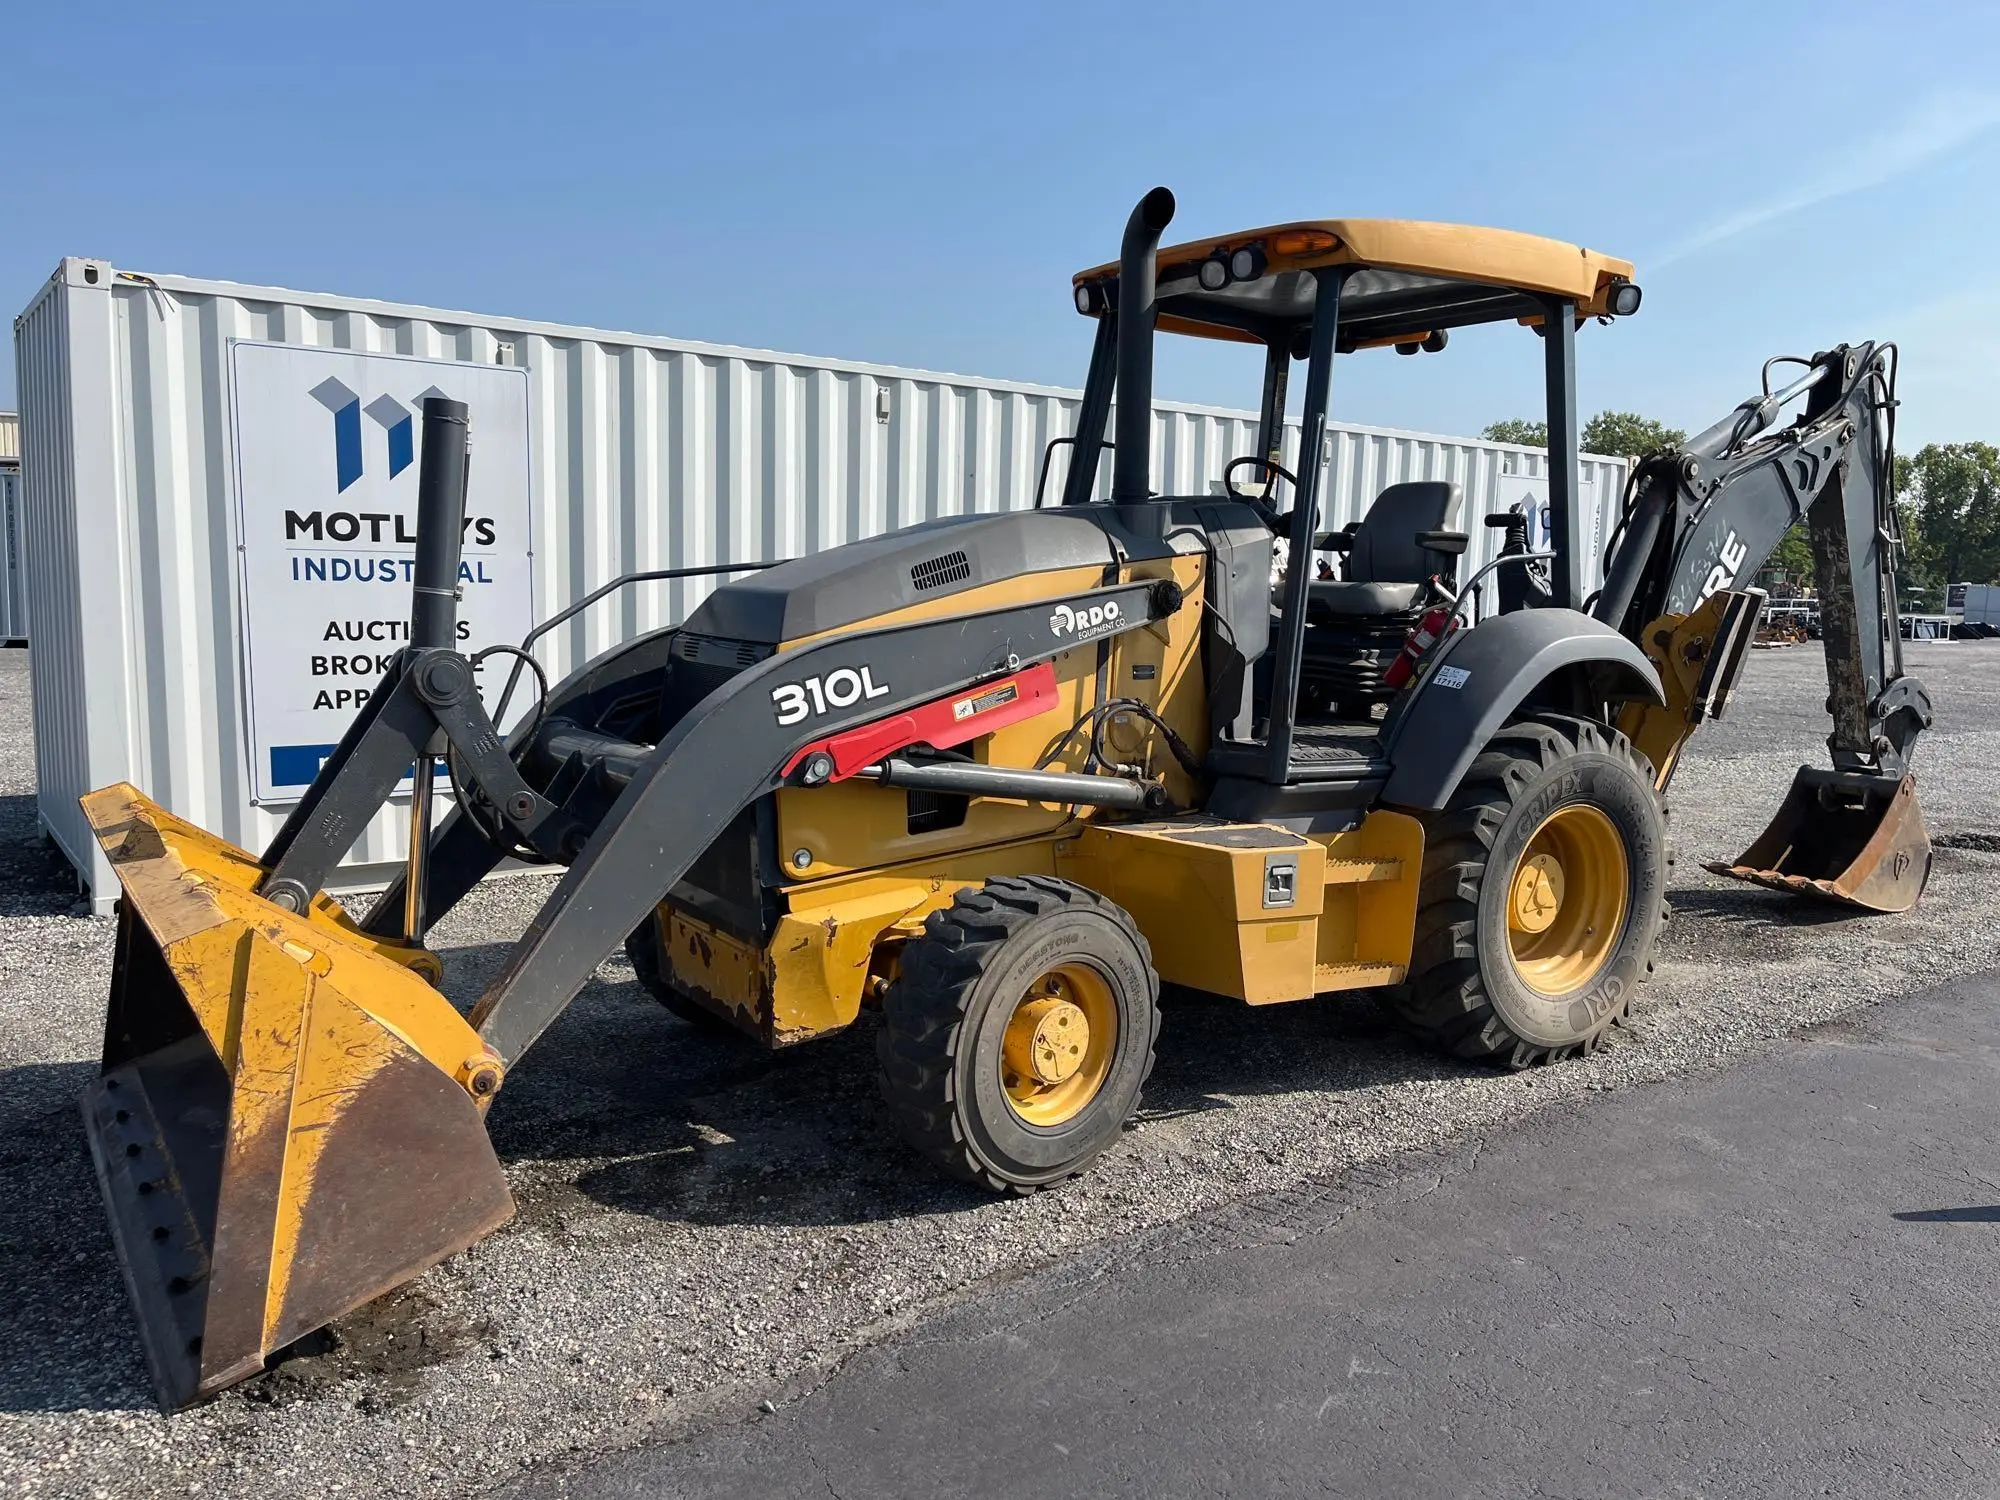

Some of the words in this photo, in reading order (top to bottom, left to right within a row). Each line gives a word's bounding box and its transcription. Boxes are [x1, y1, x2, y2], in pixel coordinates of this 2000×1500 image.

[285, 510, 496, 546] MOTLYS
[292, 557, 493, 584] INDUSTAL
[323, 620, 470, 642] AUCTIS
[1078, 621, 1114, 640] EQUIPMENT
[772, 666, 890, 725] 310L
[1582, 975, 1624, 1025] GRI
